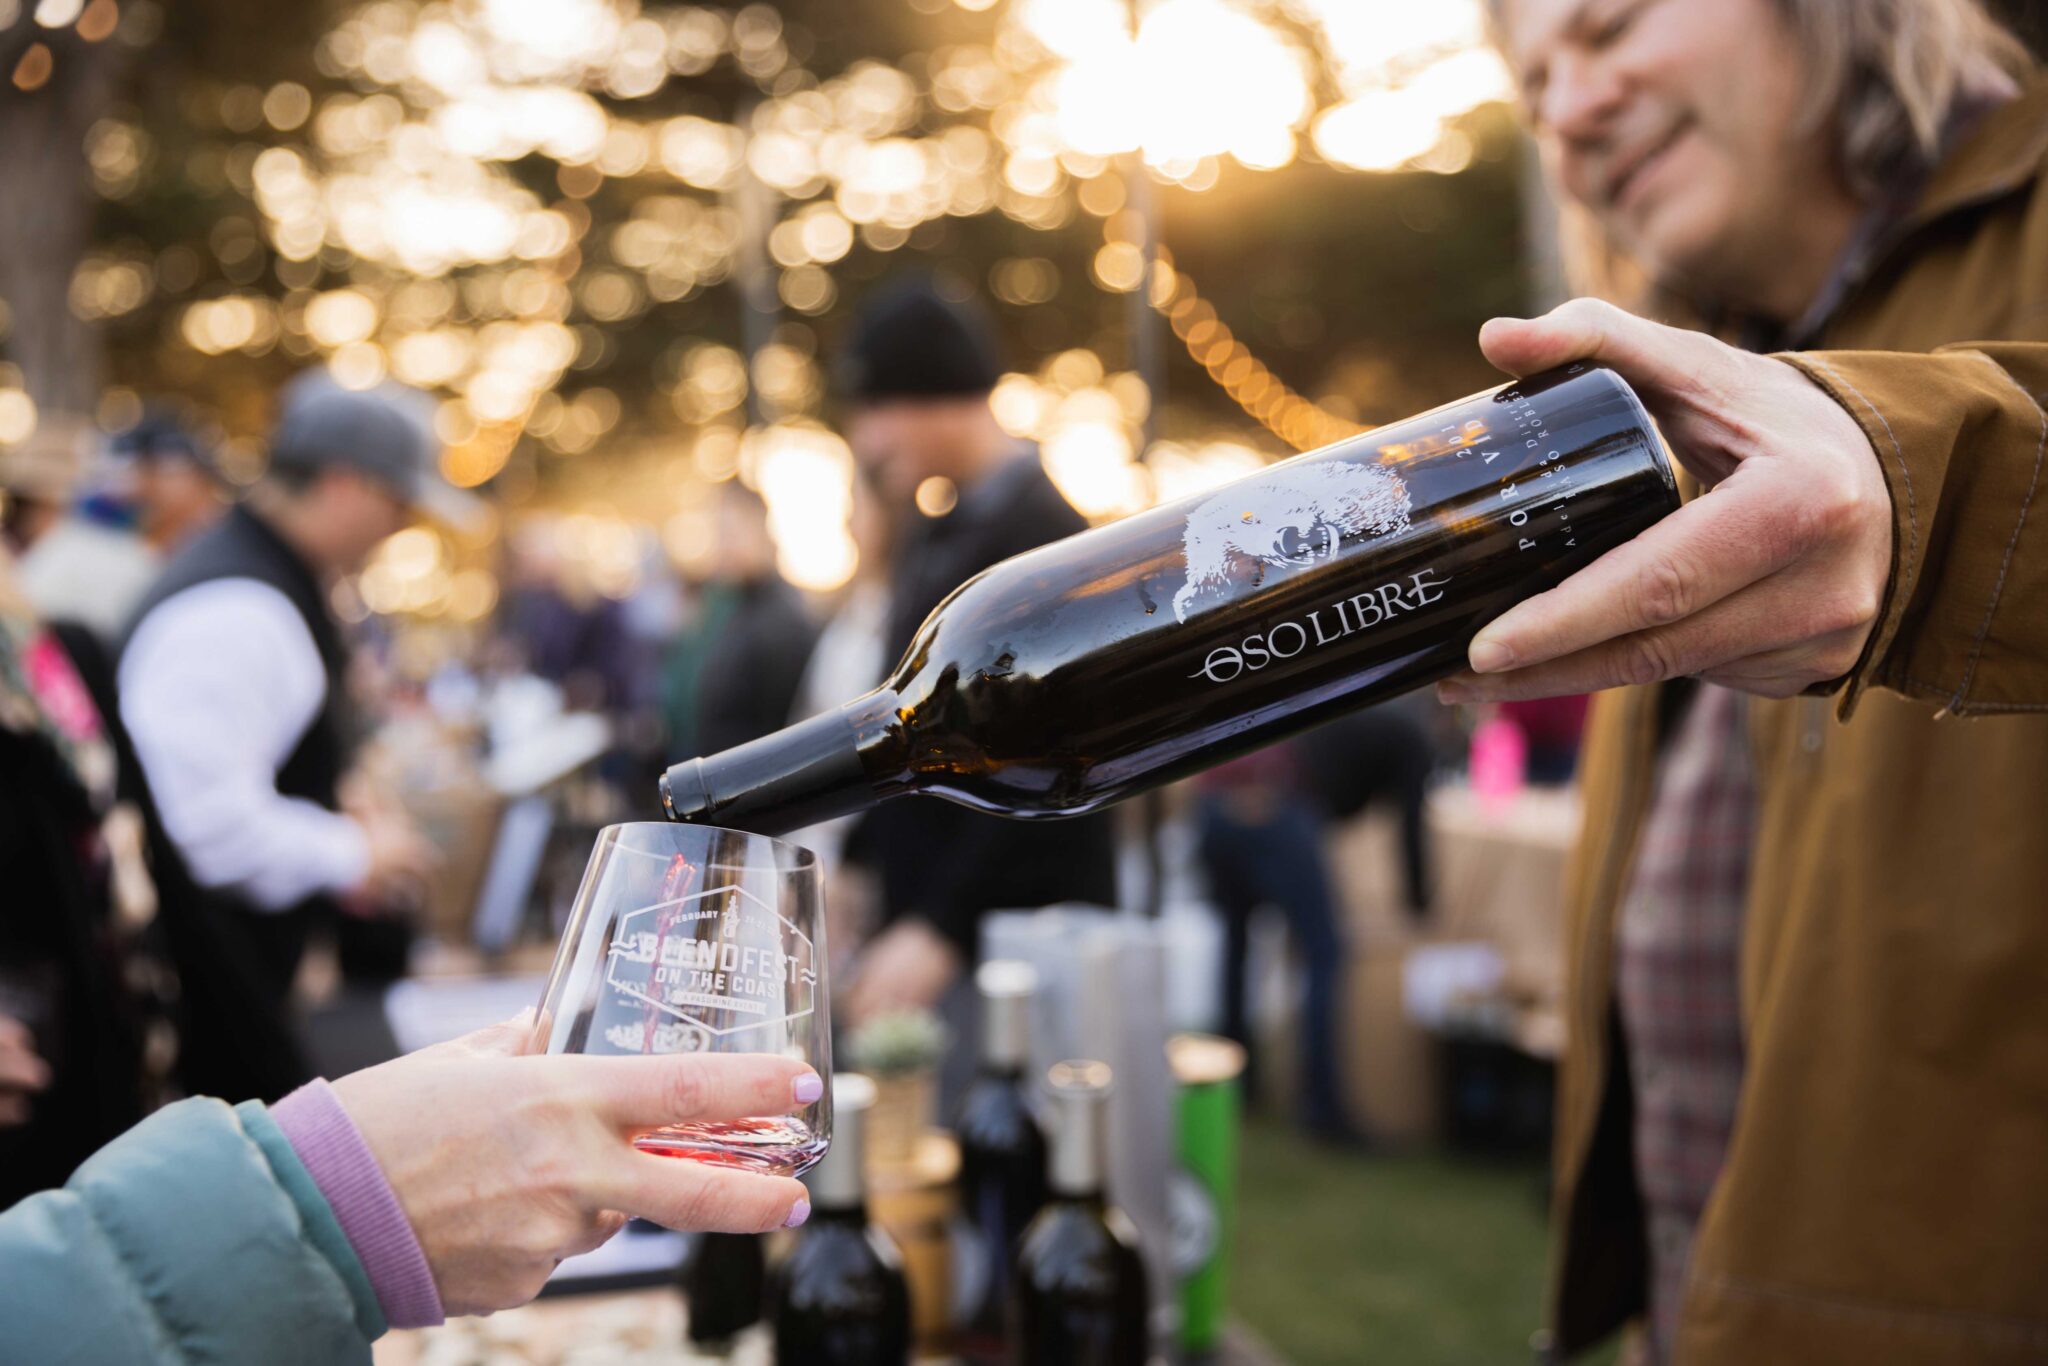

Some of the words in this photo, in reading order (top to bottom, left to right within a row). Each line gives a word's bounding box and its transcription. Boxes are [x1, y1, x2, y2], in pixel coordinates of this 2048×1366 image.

[1507, 391, 1550, 439] ROBLES
[1500, 483, 1537, 551] POR
[1187, 622, 1307, 683] OSO
[1306, 567, 1454, 647] LIBRE
[670, 910, 719, 927] FEBRUARY
[639, 934, 800, 984] BLENDFEST
[654, 967, 682, 985] ON
[690, 970, 726, 990] THE
[732, 976, 787, 1000] COAST
